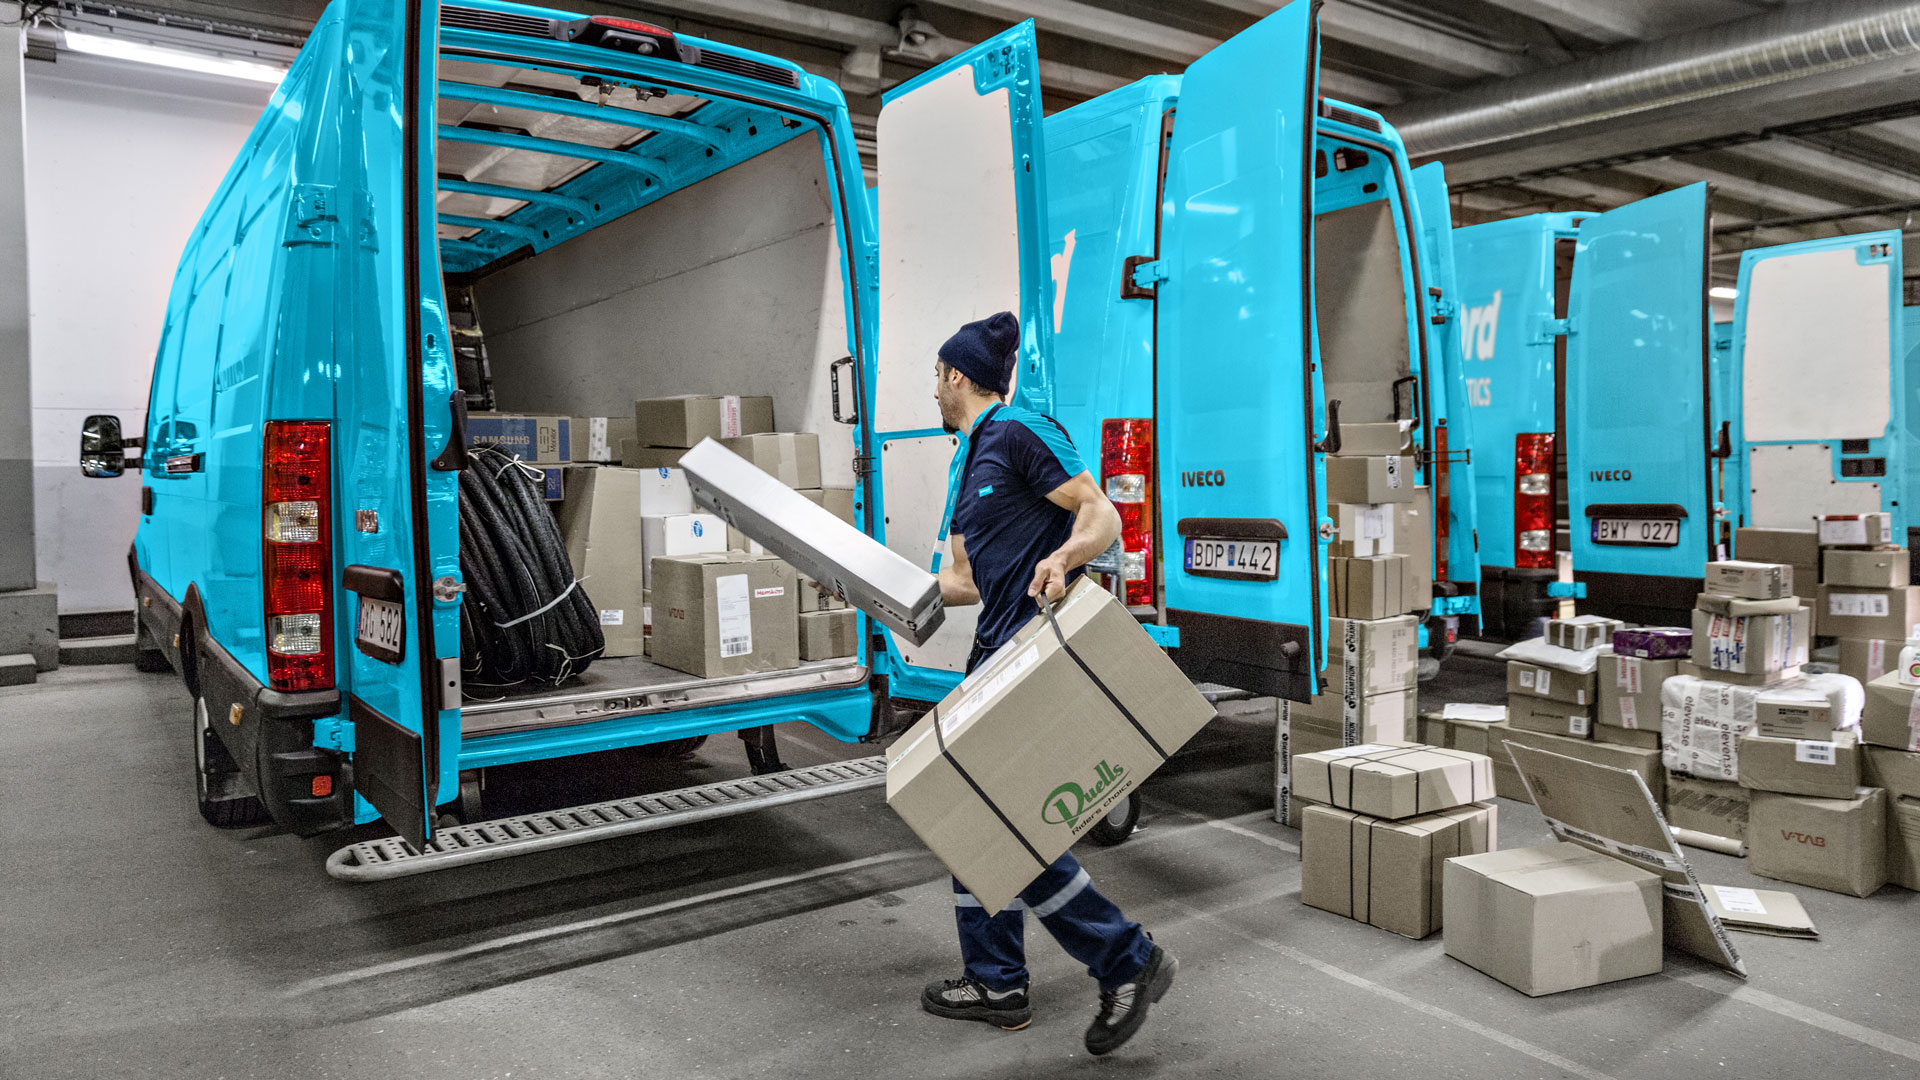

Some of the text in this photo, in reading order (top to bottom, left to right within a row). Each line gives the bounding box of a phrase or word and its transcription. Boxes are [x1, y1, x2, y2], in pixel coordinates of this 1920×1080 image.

[473, 435, 530, 445] SAMSUNG
[1181, 469, 1226, 488] IVECO
[1590, 469, 1632, 482] IVECO
[1600, 521, 1674, 541] BWY 027
[1195, 543, 1273, 572] BDP 442
[380, 606, 400, 647] 582
[1681, 695, 1695, 747] eleven.se
[1720, 723, 1732, 776] eleven.se
[1041, 760, 1125, 830] Duells
[1071, 780, 1133, 836] Riders choice
[1781, 829, 1826, 848] V-TAB
